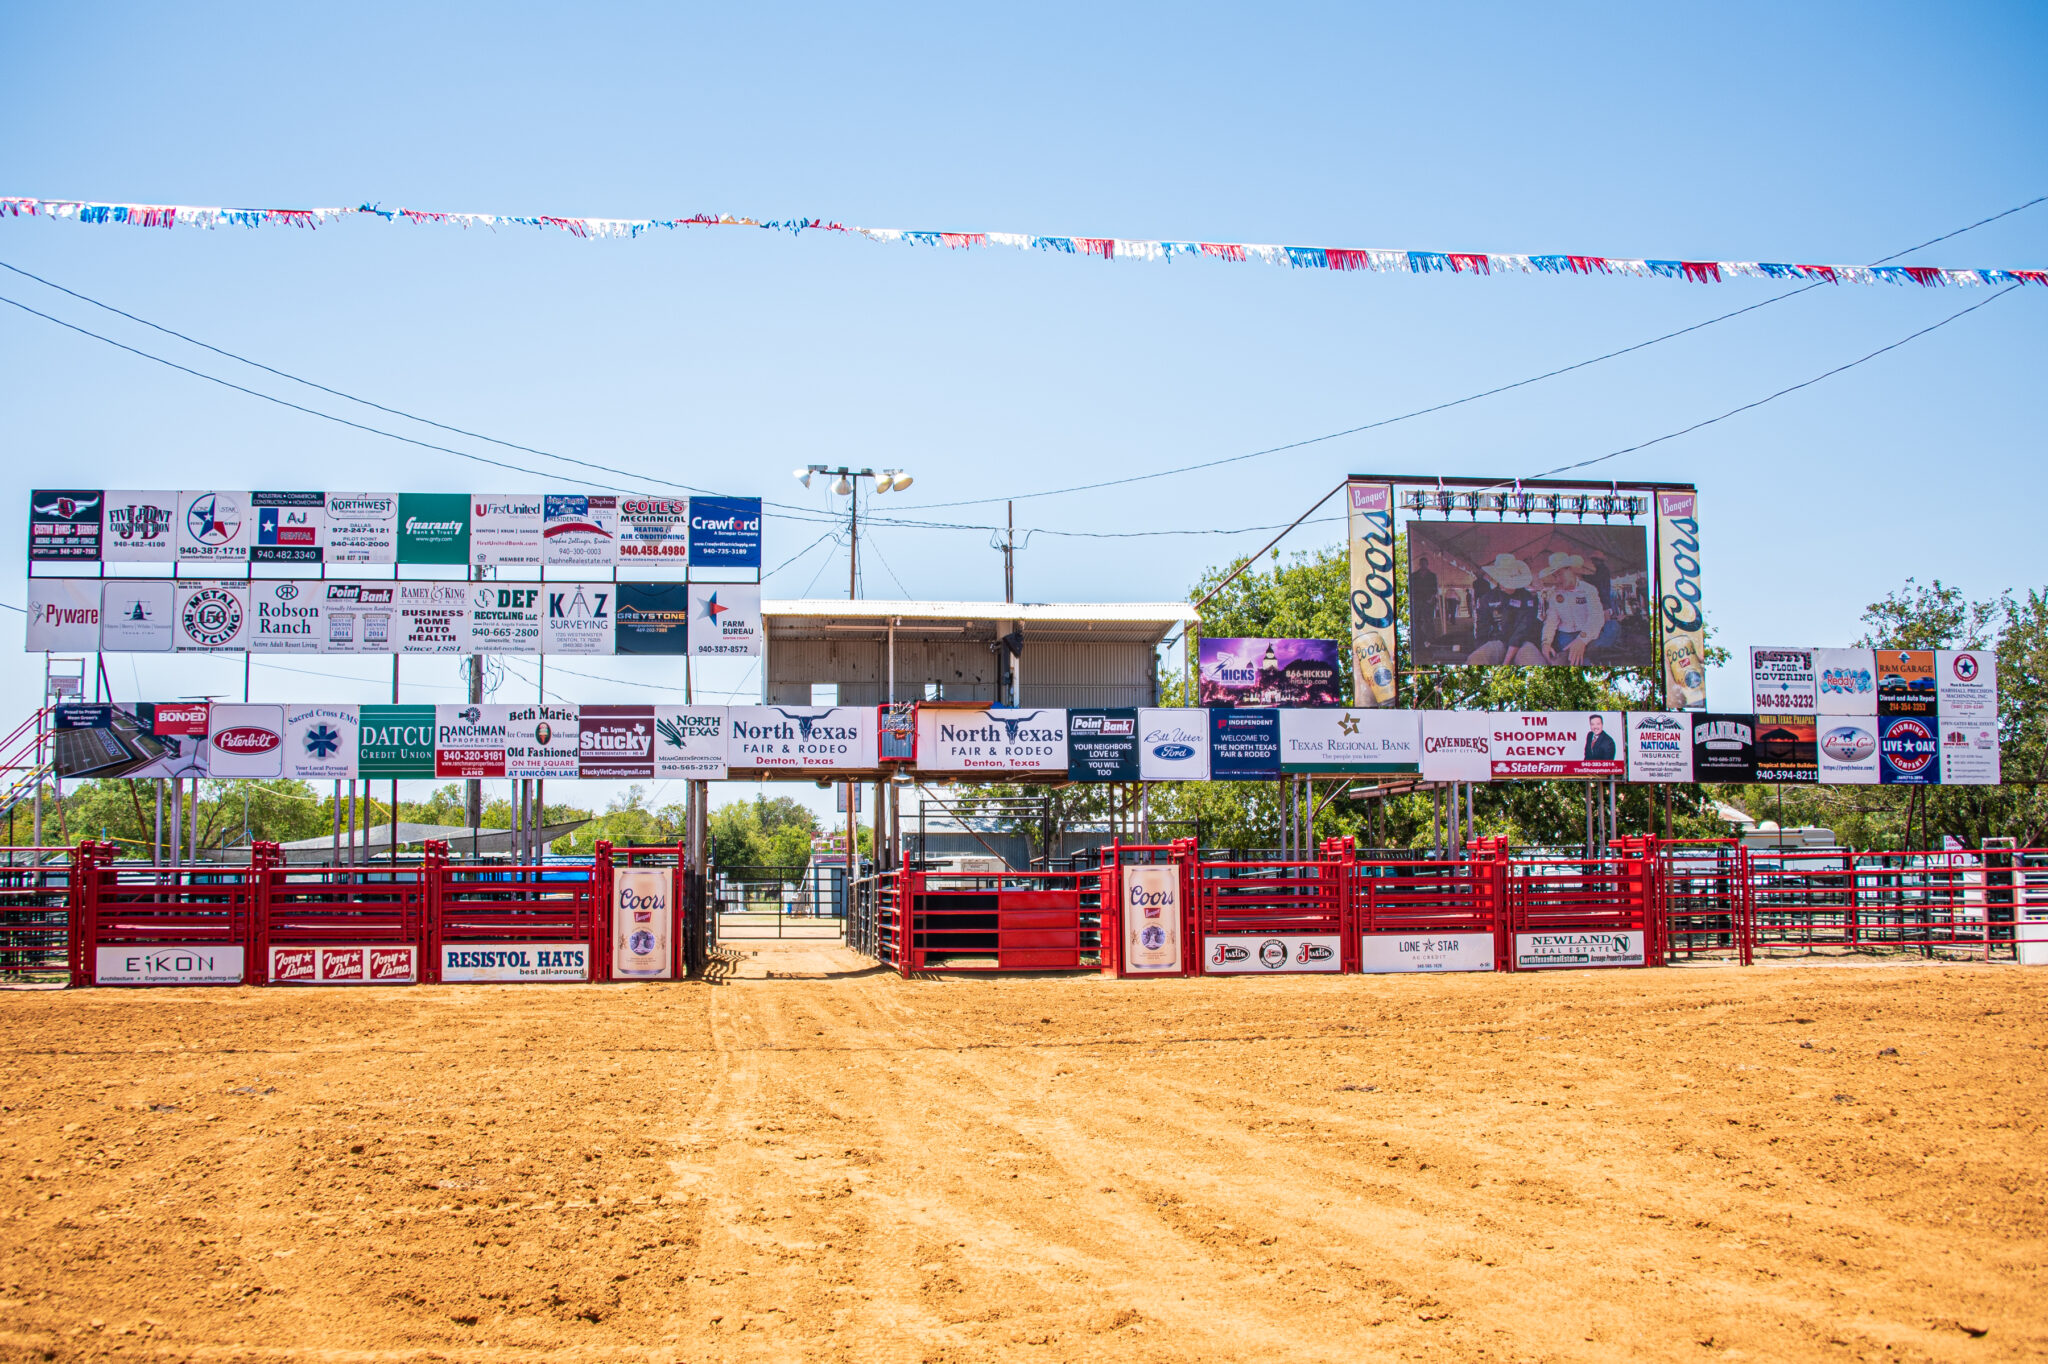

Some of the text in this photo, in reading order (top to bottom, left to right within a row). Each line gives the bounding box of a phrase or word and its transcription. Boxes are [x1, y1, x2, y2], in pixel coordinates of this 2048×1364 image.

[1354, 488, 1386, 507] Banquet
[331, 500, 393, 512] NORTHWEST
[1662, 497, 1693, 515] Banquet
[287, 512, 309, 524] AJ
[691, 517, 760, 531] Crawford
[405, 516, 464, 535] Guaranty
[179, 547, 247, 555] 940-387-1718
[257, 551, 316, 560] 940.482.3340
[620, 545, 686, 556] 940.458.4980
[1352, 511, 1393, 630] Coors
[1661, 517, 1703, 634] Coors
[328, 586, 391, 602] Point Bank
[401, 586, 465, 598] RAMEY KING
[189, 590, 236, 609] METAL
[498, 589, 538, 608] DEF
[46, 604, 99, 627] Pyware
[258, 602, 320, 617] Robson
[475, 611, 523, 620] RECYCLING
[184, 614, 241, 645] RECYCLING
[260, 619, 312, 634] Ranch
[550, 620, 608, 630] SURVEYING
[722, 620, 745, 628] FARM
[472, 628, 540, 638] 940-665-2800
[699, 645, 749, 653] 940-387-8572
[1221, 669, 1255, 681] HICKS
[1902, 665, 1933, 673] GARAGE
[1755, 673, 1814, 681] COVERING
[1827, 674, 1856, 688] Reddy
[158, 711, 207, 722] BONDED
[288, 709, 359, 726] Sacred Cross EMS
[509, 706, 579, 721] Beth Marie's
[676, 715, 720, 727] NORTH
[1074, 718, 1130, 732] Point Bank
[1521, 717, 1547, 726] TIM
[440, 725, 506, 743] RANCHMAN
[610, 727, 627, 735] Lynn
[680, 727, 719, 737] TEXAS
[733, 720, 795, 740] North
[940, 724, 1001, 742] North
[1892, 722, 1924, 737] PLUMBING
[220, 731, 276, 748] Peterbilt
[361, 726, 434, 747] DATCU
[1493, 731, 1577, 741] SHOOPMAN
[1640, 732, 1681, 741] AMERICAN
[580, 731, 651, 757] Stucky
[743, 744, 847, 753] FAIR & RODEO
[1289, 739, 1410, 751] TEXAS REGIONAL BANK
[1425, 736, 1489, 754] CAVENDER'S
[1641, 742, 1680, 750] NATIONAL
[1882, 740, 1936, 752] LIVE OAK
[361, 749, 432, 759] CREDIT UNION
[507, 747, 579, 757] Old Fashioned
[951, 746, 1053, 756] FAIR & RODEO
[1089, 750, 1108, 758] LOVE
[1160, 746, 1188, 757] Ford
[1505, 746, 1565, 756] AGENCY
[543, 760, 575, 768] SQUARE
[755, 756, 798, 766] Denton,
[963, 759, 1041, 768] Denton, Texas
[1894, 757, 1924, 769] COMPANY
[1756, 770, 1819, 780] 940-594-8211
[620, 888, 665, 910] Coors
[1130, 885, 1174, 906] Coors
[1399, 940, 1459, 952] LONE STAR
[1531, 934, 1612, 946] NEWLAND
[1213, 945, 1249, 964] Justin
[1297, 943, 1333, 963] Justin
[1569, 946, 1610, 954] ESTATE
[276, 952, 303, 970] Tony
[324, 952, 351, 970] Tony
[371, 952, 398, 970] Tony
[447, 950, 585, 968] RESISTOL HATS
[281, 963, 315, 979] Lama
[329, 963, 363, 979] Lama
[376, 963, 410, 979] Lama
